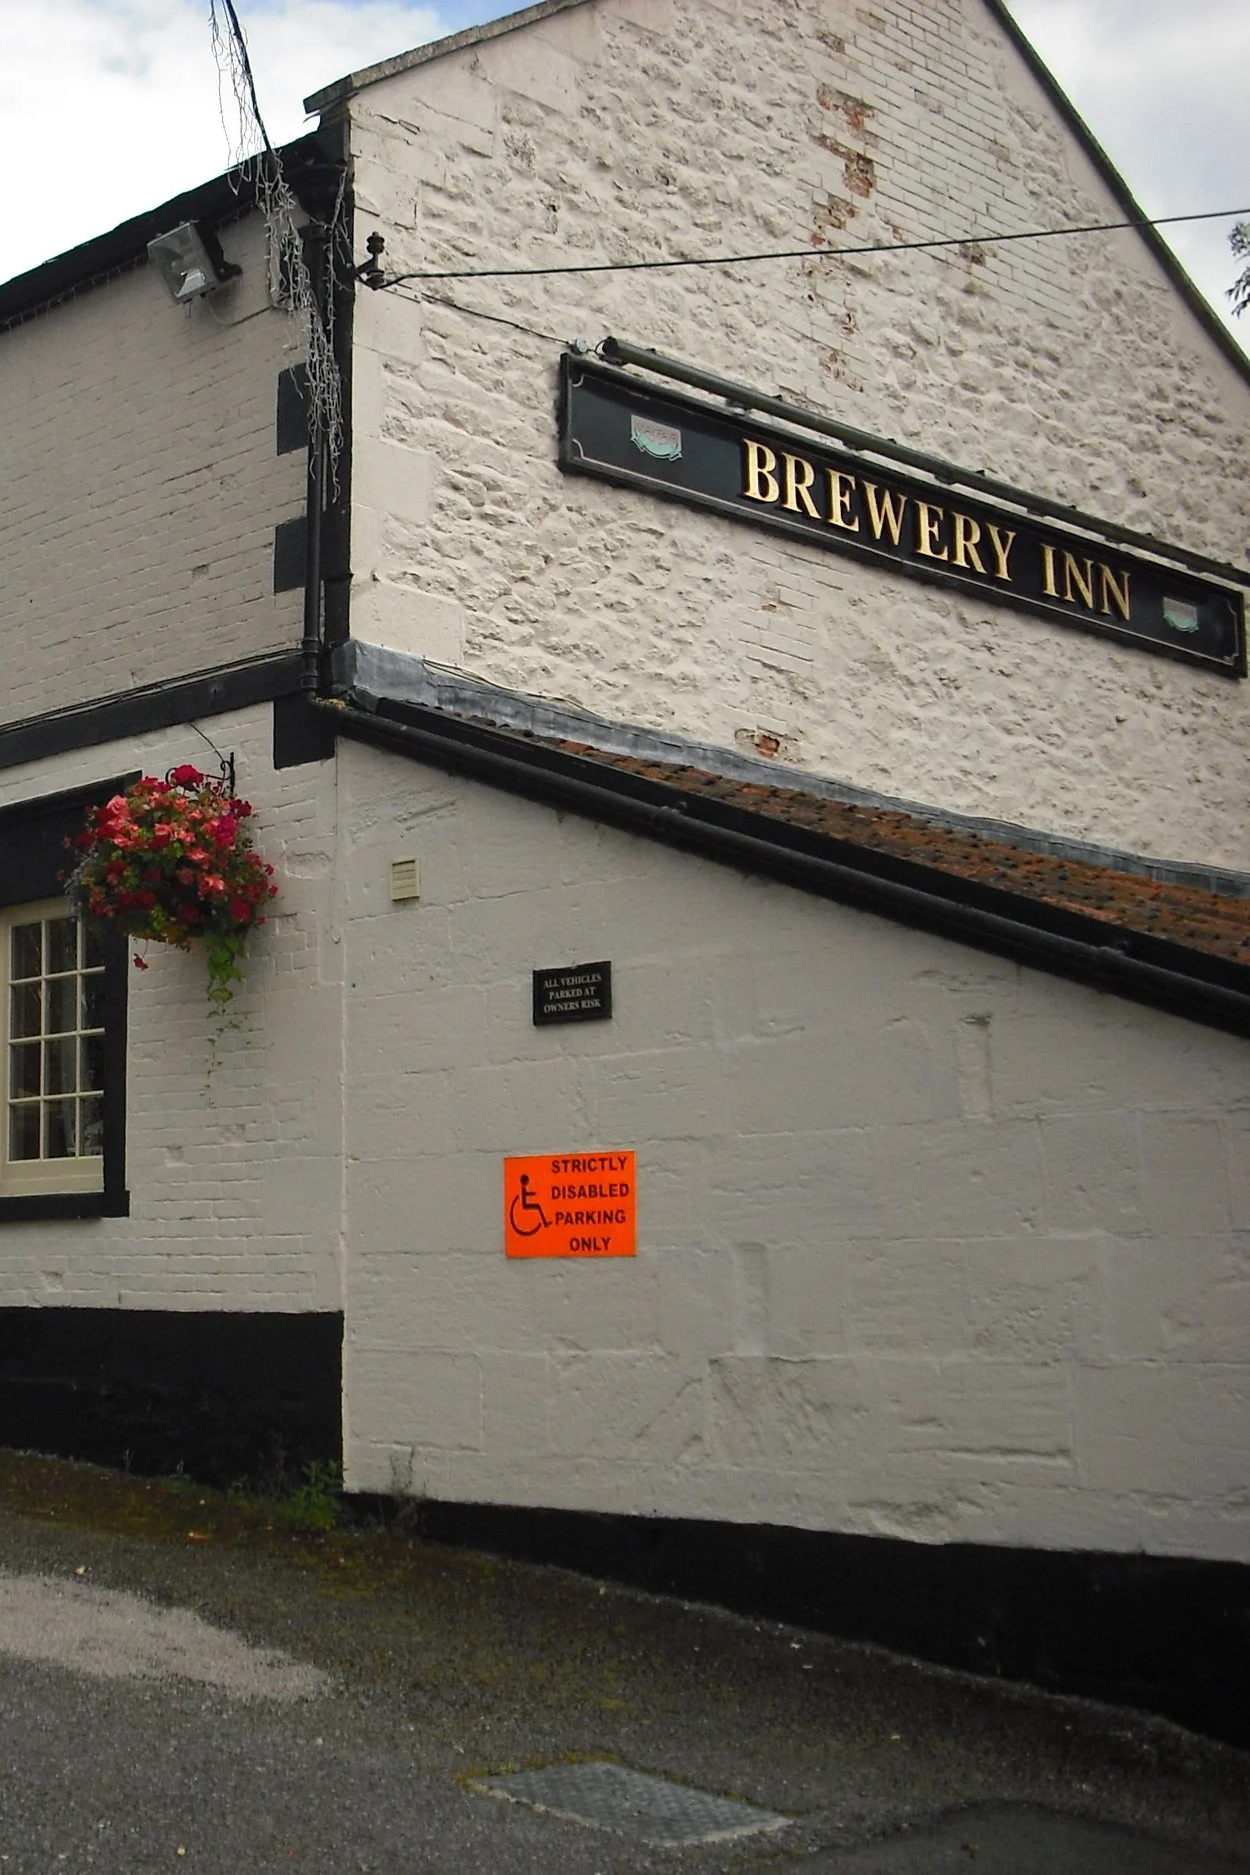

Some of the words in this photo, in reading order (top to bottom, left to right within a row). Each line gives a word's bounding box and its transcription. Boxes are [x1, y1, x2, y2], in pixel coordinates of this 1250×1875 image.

[742, 439, 1016, 581] BREWERY
[1040, 543, 1131, 621] INN
[543, 979, 559, 988] ALL
[561, 973, 602, 986] VEHICLES
[549, 988, 582, 1000] PARKED
[584, 986, 596, 997] AT
[543, 1001, 580, 1014] OWNERS
[581, 998, 602, 1009] RISK
[551, 1156, 628, 1174] STRICTLY
[551, 1183, 629, 1200] DISABLED
[555, 1209, 626, 1226] PARKING
[569, 1236, 611, 1252] ONLY
